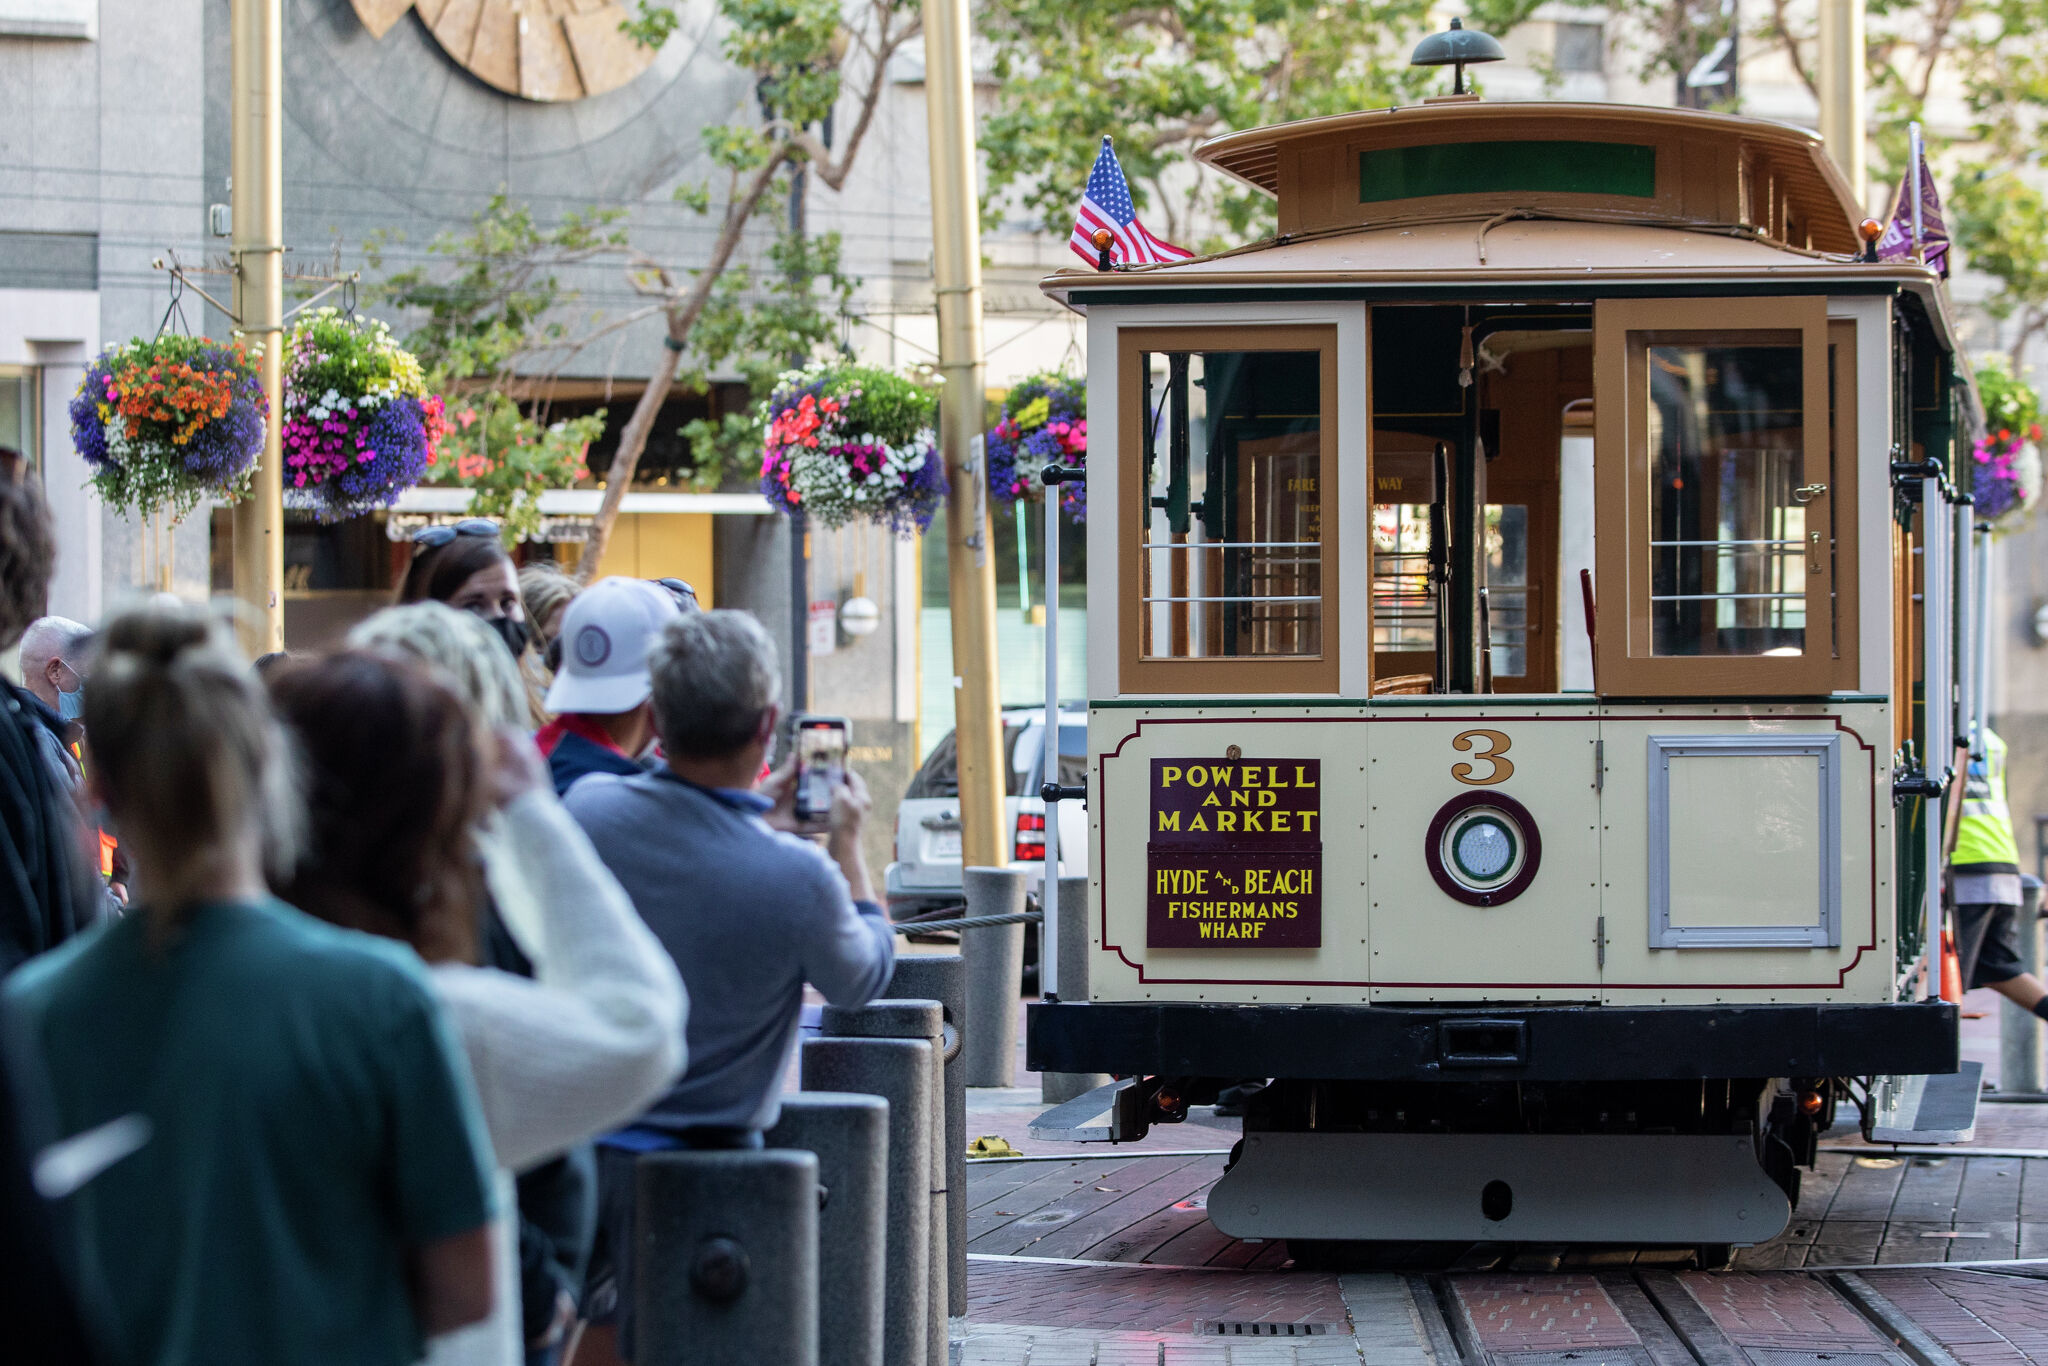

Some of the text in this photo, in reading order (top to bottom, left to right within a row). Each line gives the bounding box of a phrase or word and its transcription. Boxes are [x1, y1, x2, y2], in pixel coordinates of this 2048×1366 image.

[1287, 477, 1404, 491] FARE WAY
[1451, 729, 1514, 786] 3
[1161, 765, 1316, 788] POWELL
[1201, 790, 1277, 807] AND
[1158, 810, 1318, 832] MARKET
[1156, 869, 1313, 895] HYDE AND BEACH
[1168, 901, 1299, 919] FISHERMANS
[1199, 921, 1267, 939] WHARF
